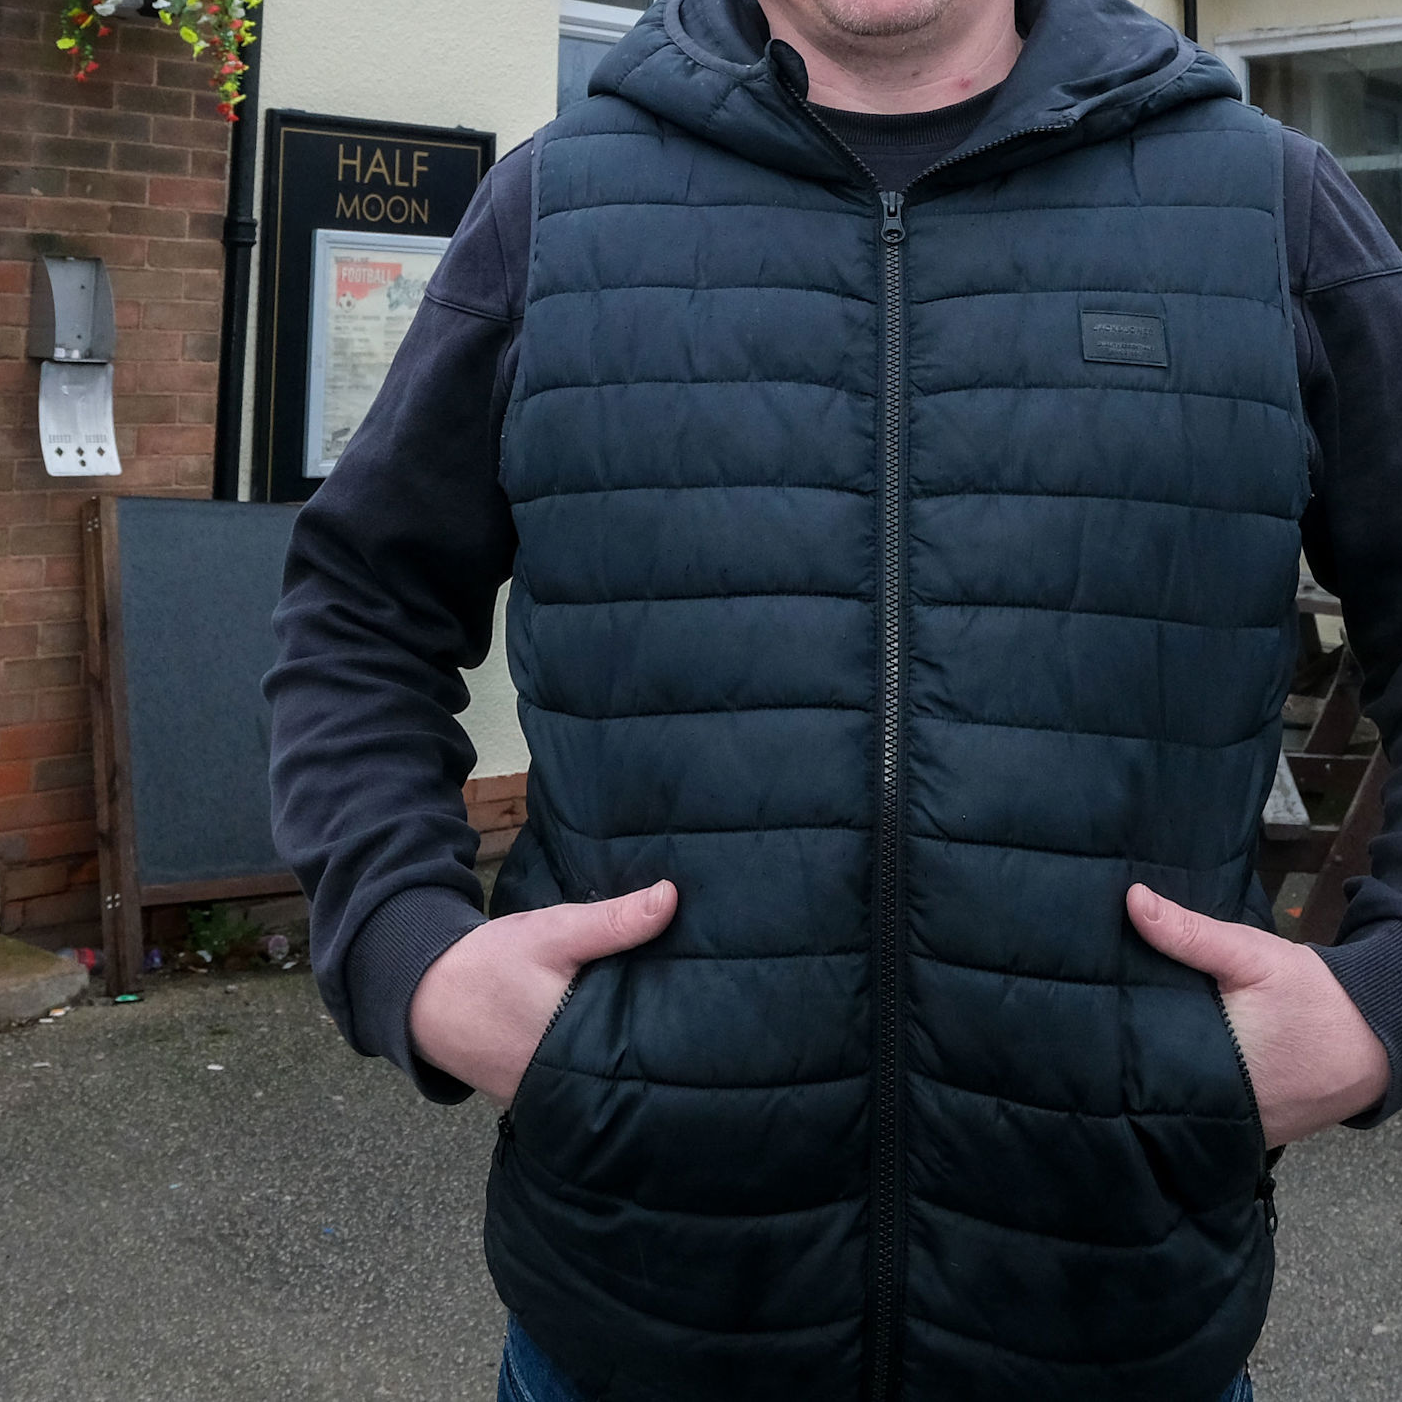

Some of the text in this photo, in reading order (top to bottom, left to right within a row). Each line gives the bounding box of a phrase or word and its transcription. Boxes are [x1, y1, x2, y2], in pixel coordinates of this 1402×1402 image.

[338, 143, 430, 188] HALF
[336, 192, 430, 225] MOON
[341, 266, 393, 285] FOOTBALL
